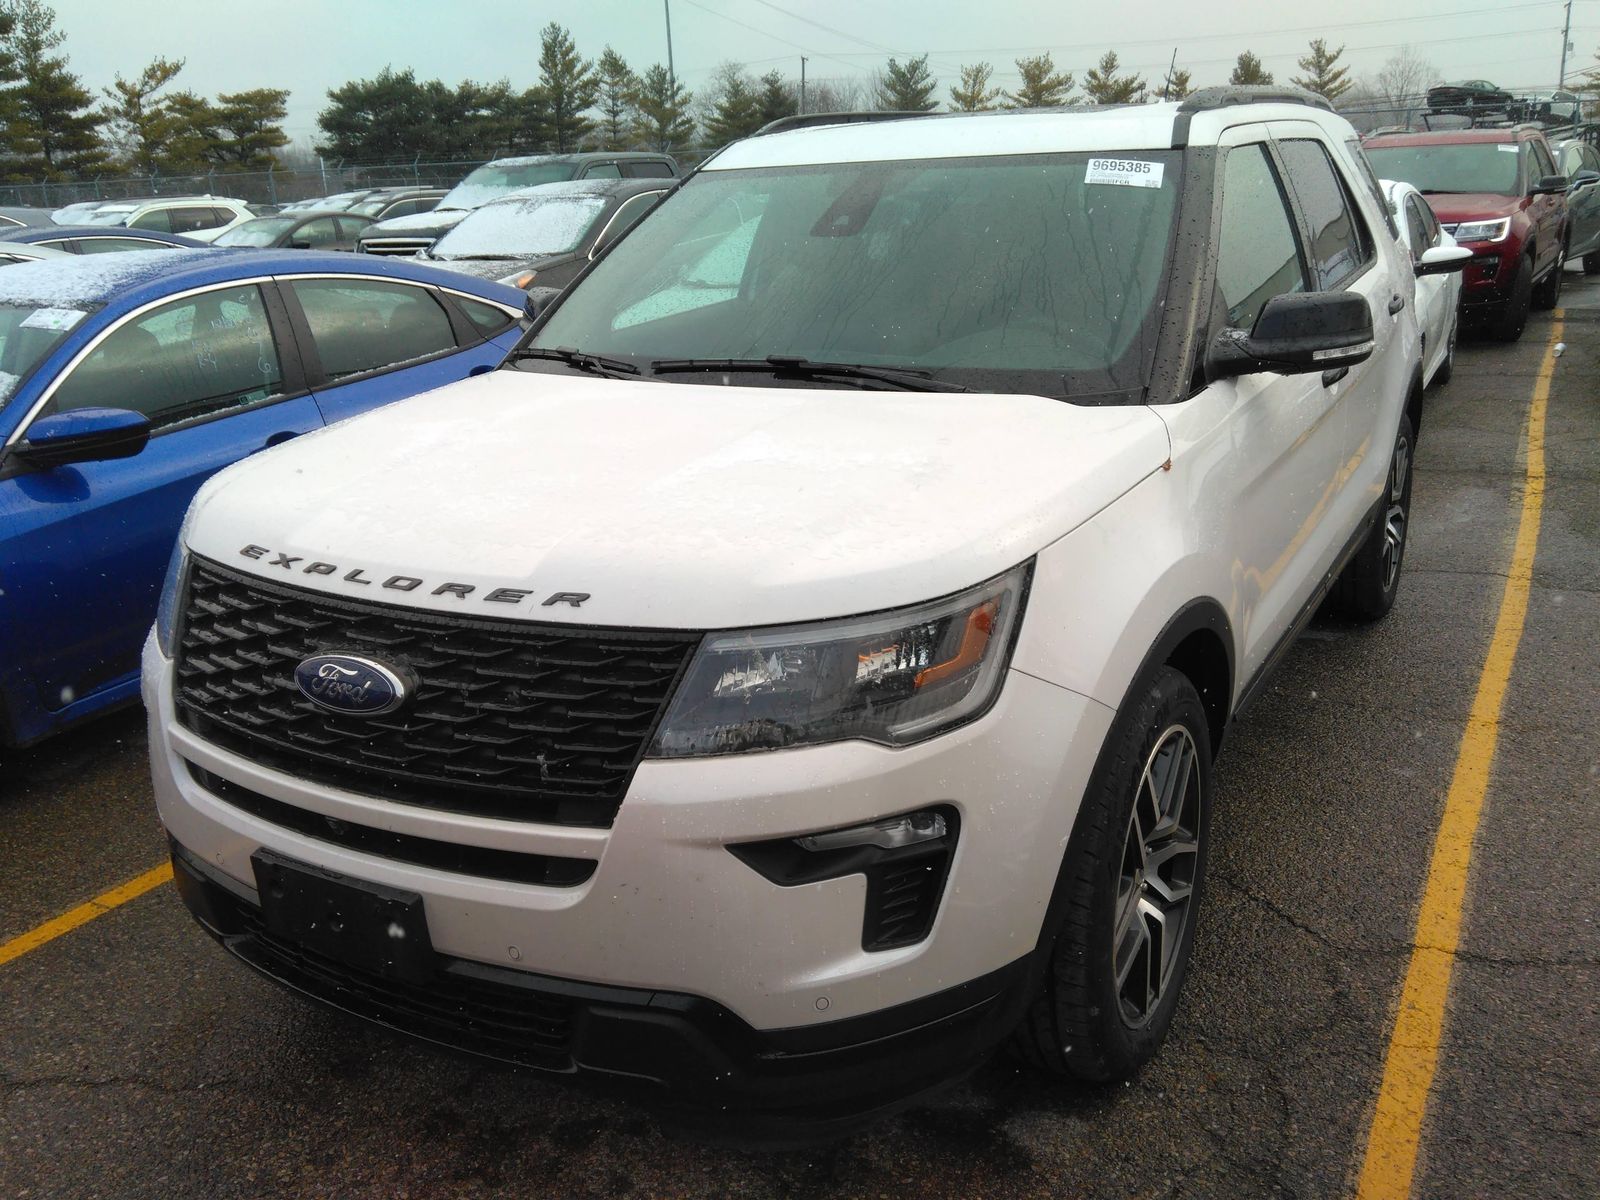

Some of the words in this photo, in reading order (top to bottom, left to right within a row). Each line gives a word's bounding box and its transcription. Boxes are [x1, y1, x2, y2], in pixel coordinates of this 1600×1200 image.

[1092, 160, 1151, 174] 9695385
[239, 543, 592, 608] EXPLORER
[311, 663, 372, 704] Ford
